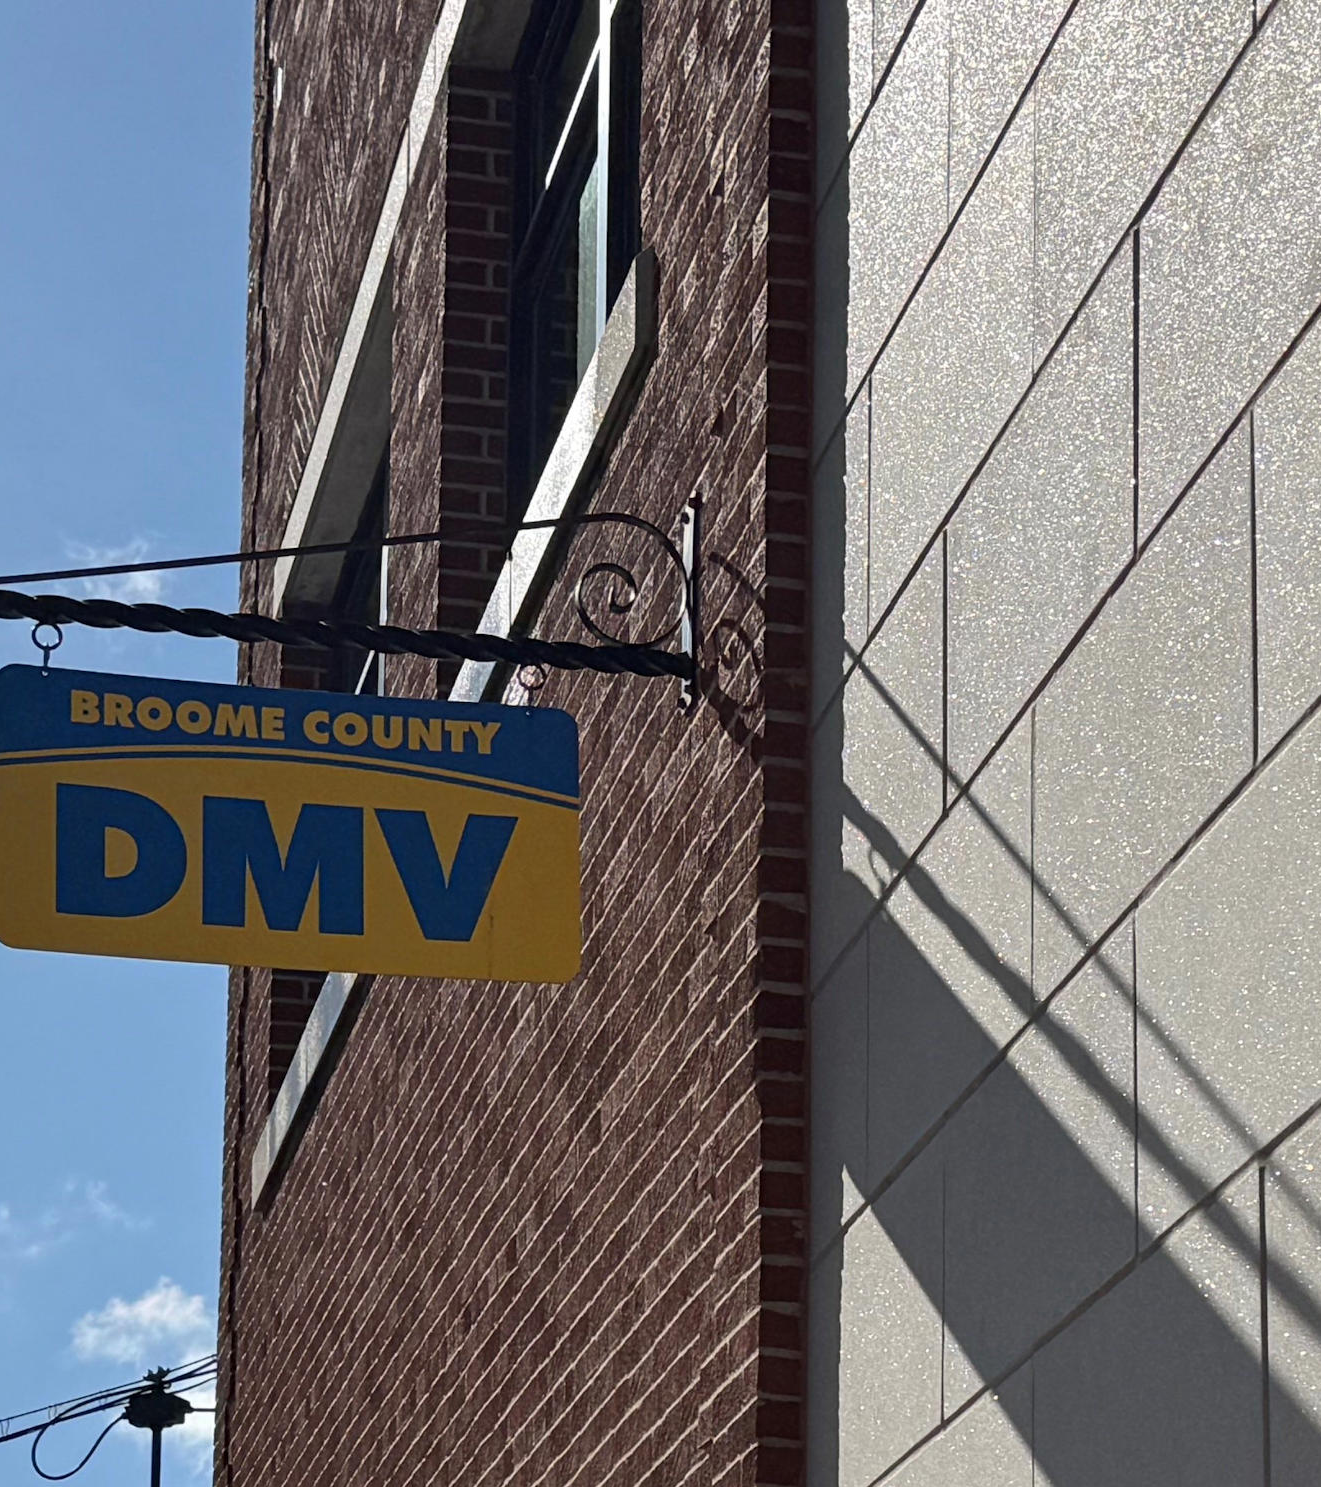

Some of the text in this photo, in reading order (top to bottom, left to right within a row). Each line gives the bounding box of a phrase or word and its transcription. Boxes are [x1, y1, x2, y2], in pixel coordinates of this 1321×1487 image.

[70, 689, 501, 755] BROOME COUNTY
[56, 782, 518, 942] DMV
